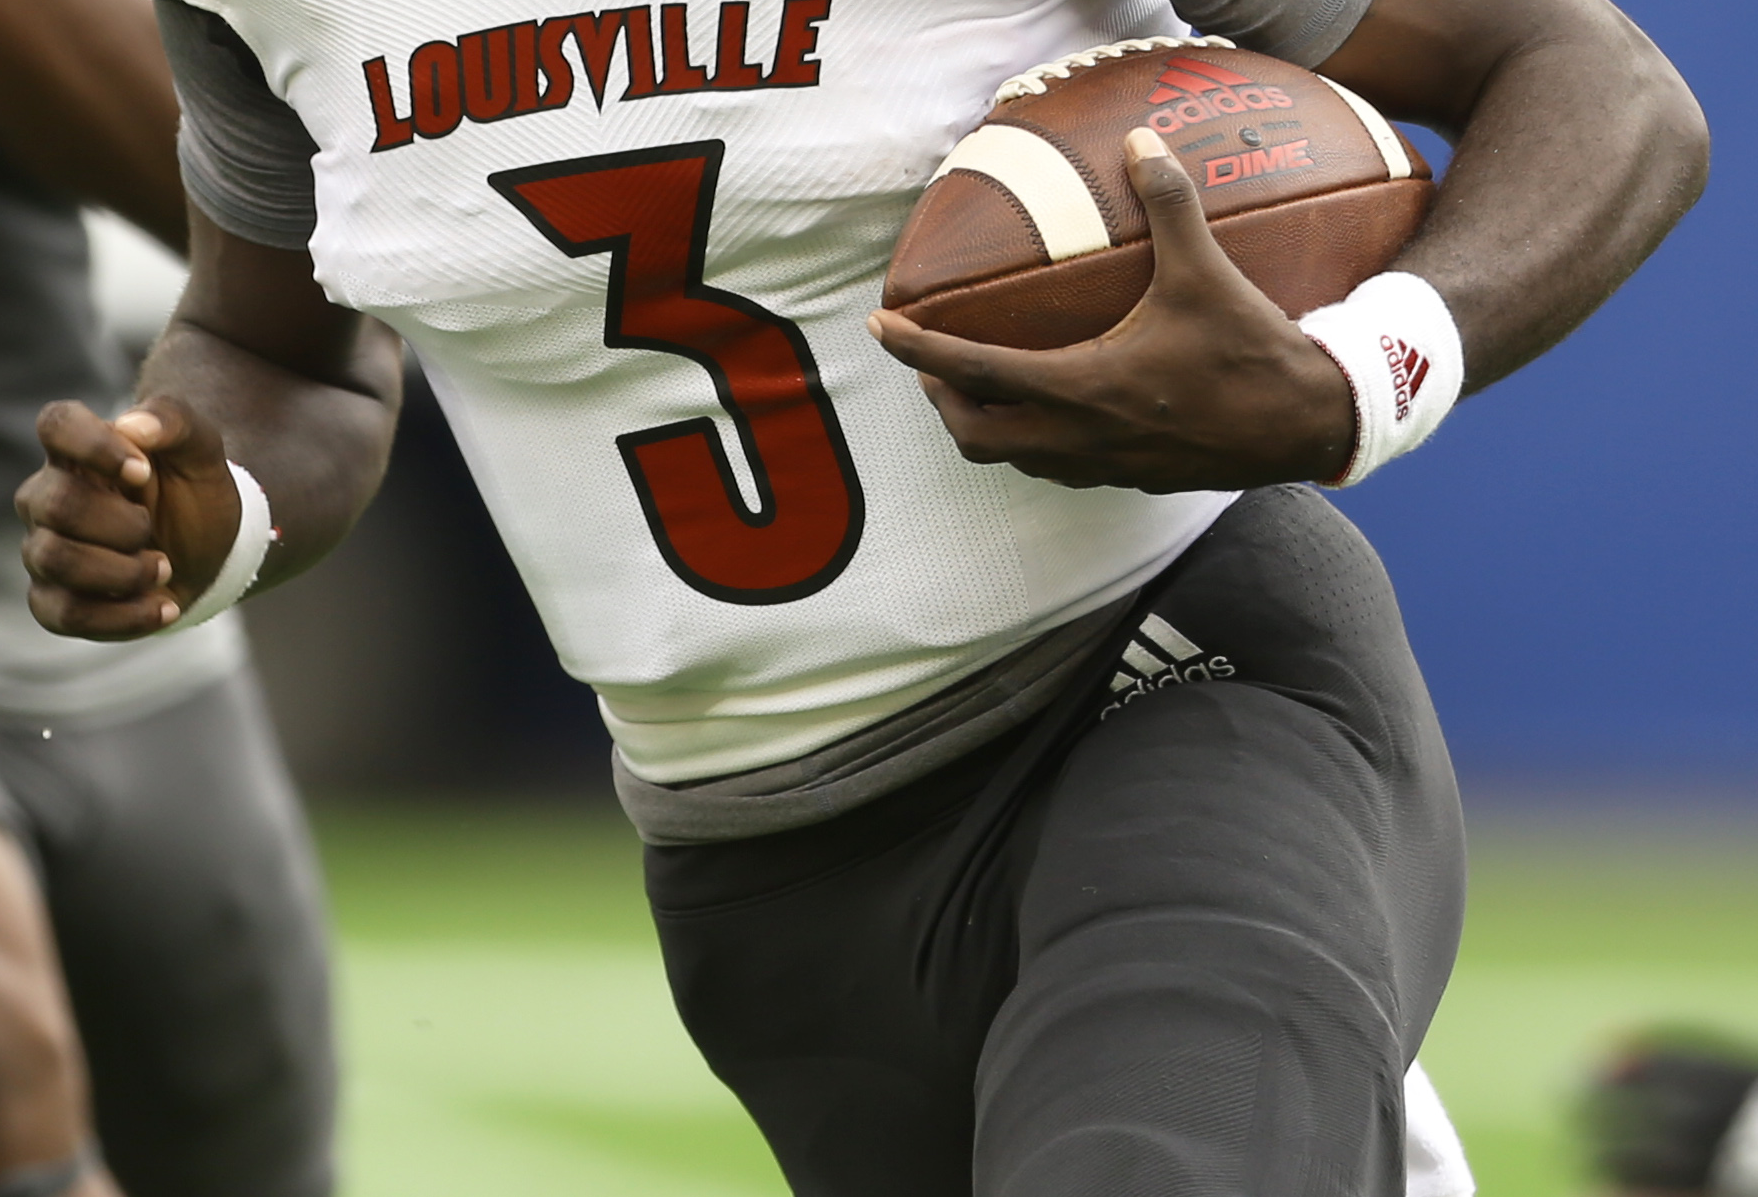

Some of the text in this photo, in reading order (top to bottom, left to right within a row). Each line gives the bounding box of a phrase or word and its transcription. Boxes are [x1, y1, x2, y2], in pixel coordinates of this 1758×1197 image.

[1148, 84, 1294, 134] adidas
[1203, 138, 1316, 189] DIME
[487, 139, 866, 606] 3
[1379, 334, 1409, 421] adidas
